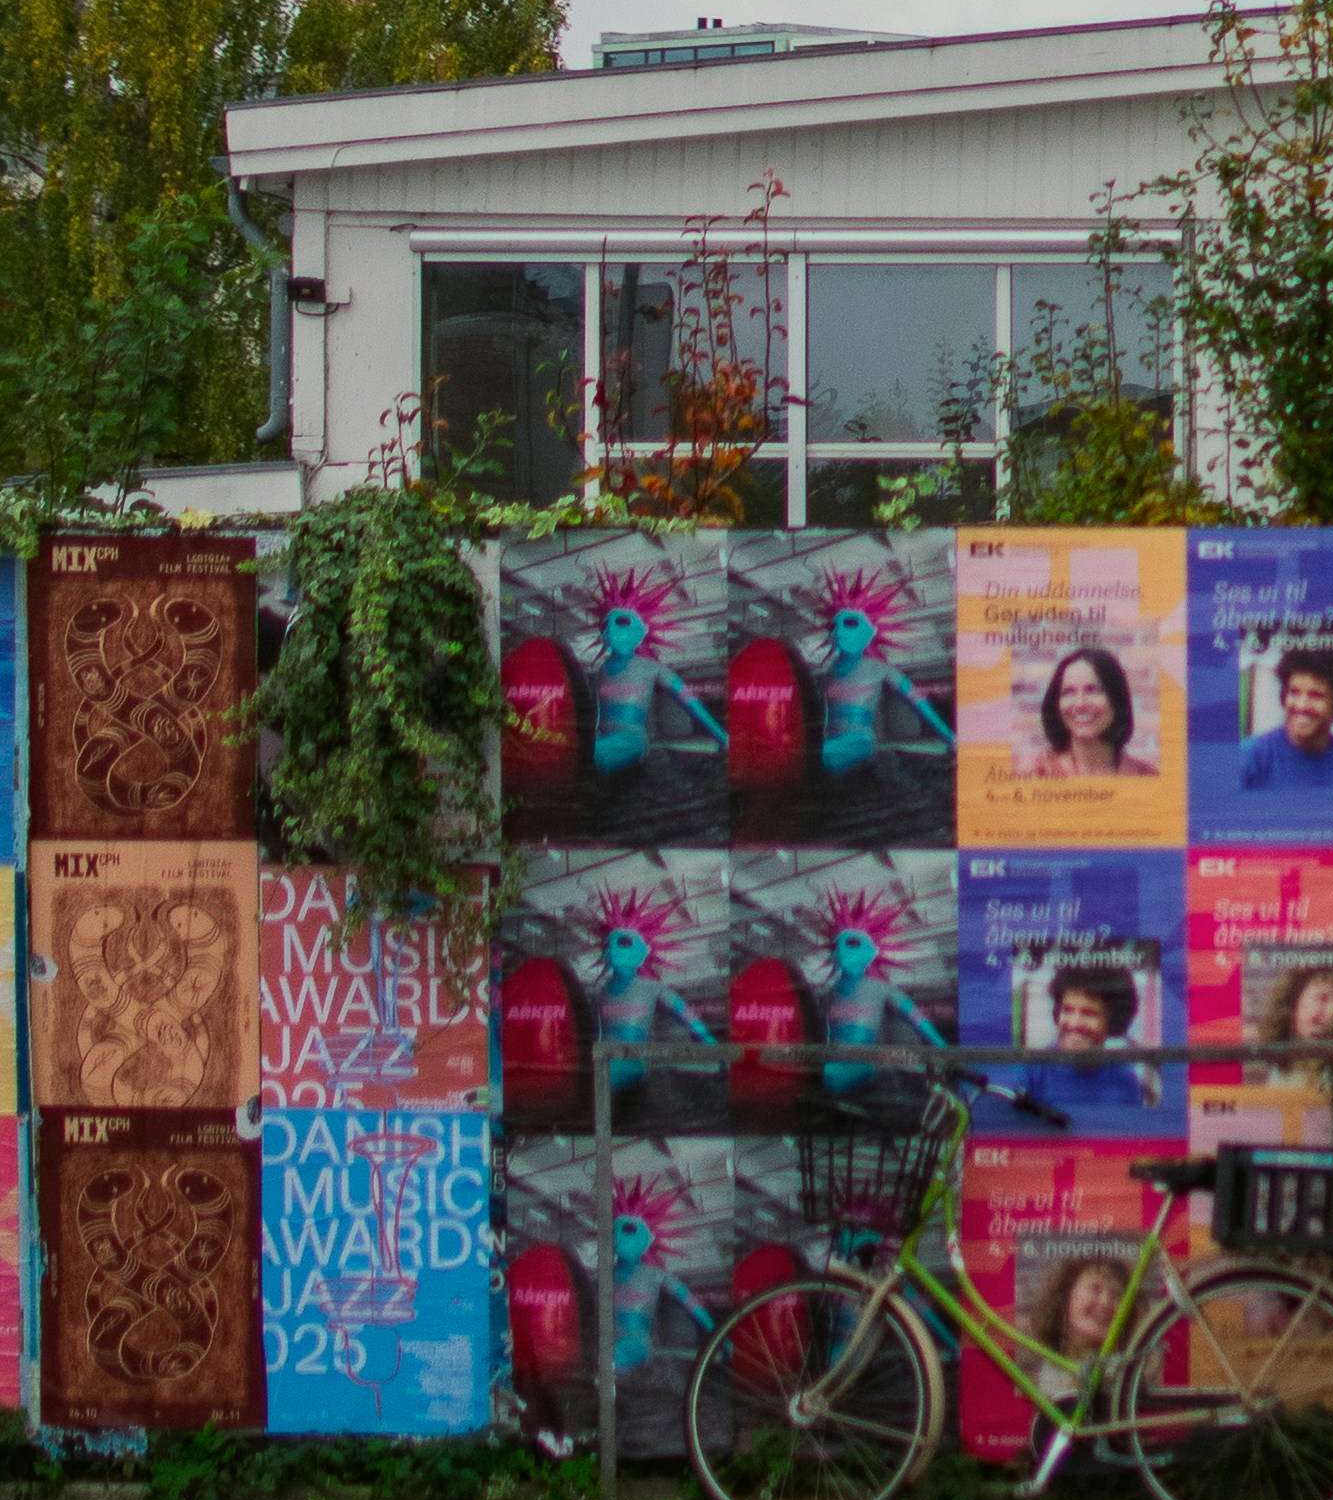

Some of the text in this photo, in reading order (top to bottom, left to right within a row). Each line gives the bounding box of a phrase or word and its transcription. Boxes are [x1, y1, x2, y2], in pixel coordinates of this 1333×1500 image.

[969, 541, 1004, 557] EK
[1198, 541, 1235, 559] EK
[159, 563, 231, 574] FILM FESTIVAL
[984, 581, 1020, 600] Din
[1212, 580, 1252, 604] Ses
[1285, 579, 1309, 602] til
[1027, 605, 1083, 624] viden
[1089, 604, 1107, 624] til
[1032, 787, 1116, 802] november
[161, 868, 232, 879] FILM FESTIVAL
[970, 858, 1006, 877] EK
[1199, 857, 1236, 877] EK
[987, 899, 1025, 921] Ses
[1057, 898, 1081, 922] til
[1213, 899, 1254, 922] Ses
[1056, 923, 1112, 946] hus?
[283, 923, 484, 975] MUSIC
[1043, 949, 1146, 969] november
[261, 1025, 420, 1075] JAZZ
[170, 1133, 193, 1144] FILM
[262, 1113, 490, 1165] DANISH
[974, 1147, 1010, 1167] EK
[283, 1166, 484, 1218] MUSIC
[987, 1189, 1028, 1211] Ses
[1060, 1186, 1085, 1209] til
[262, 1217, 490, 1270] AWARDS
[262, 1268, 420, 1318] JAZZ
